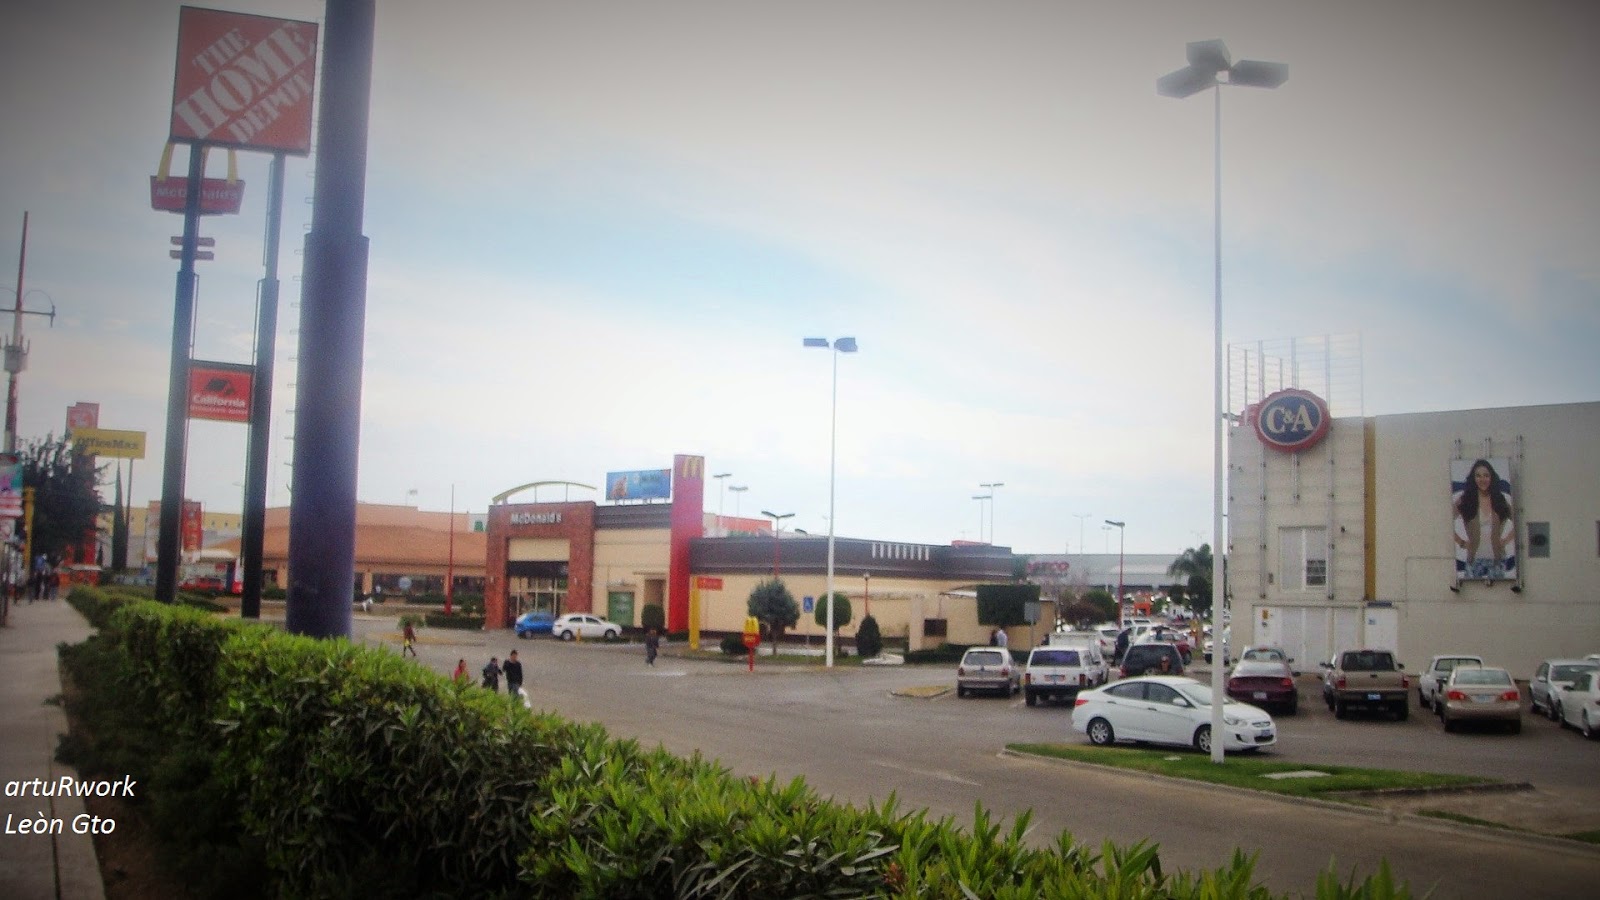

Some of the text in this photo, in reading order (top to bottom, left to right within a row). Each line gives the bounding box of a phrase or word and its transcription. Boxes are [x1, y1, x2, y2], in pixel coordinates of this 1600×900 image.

[174, 22, 316, 139] HOME
[192, 28, 250, 76] THE
[228, 70, 313, 142] DEPOT
[1266, 404, 1314, 433] C&A
